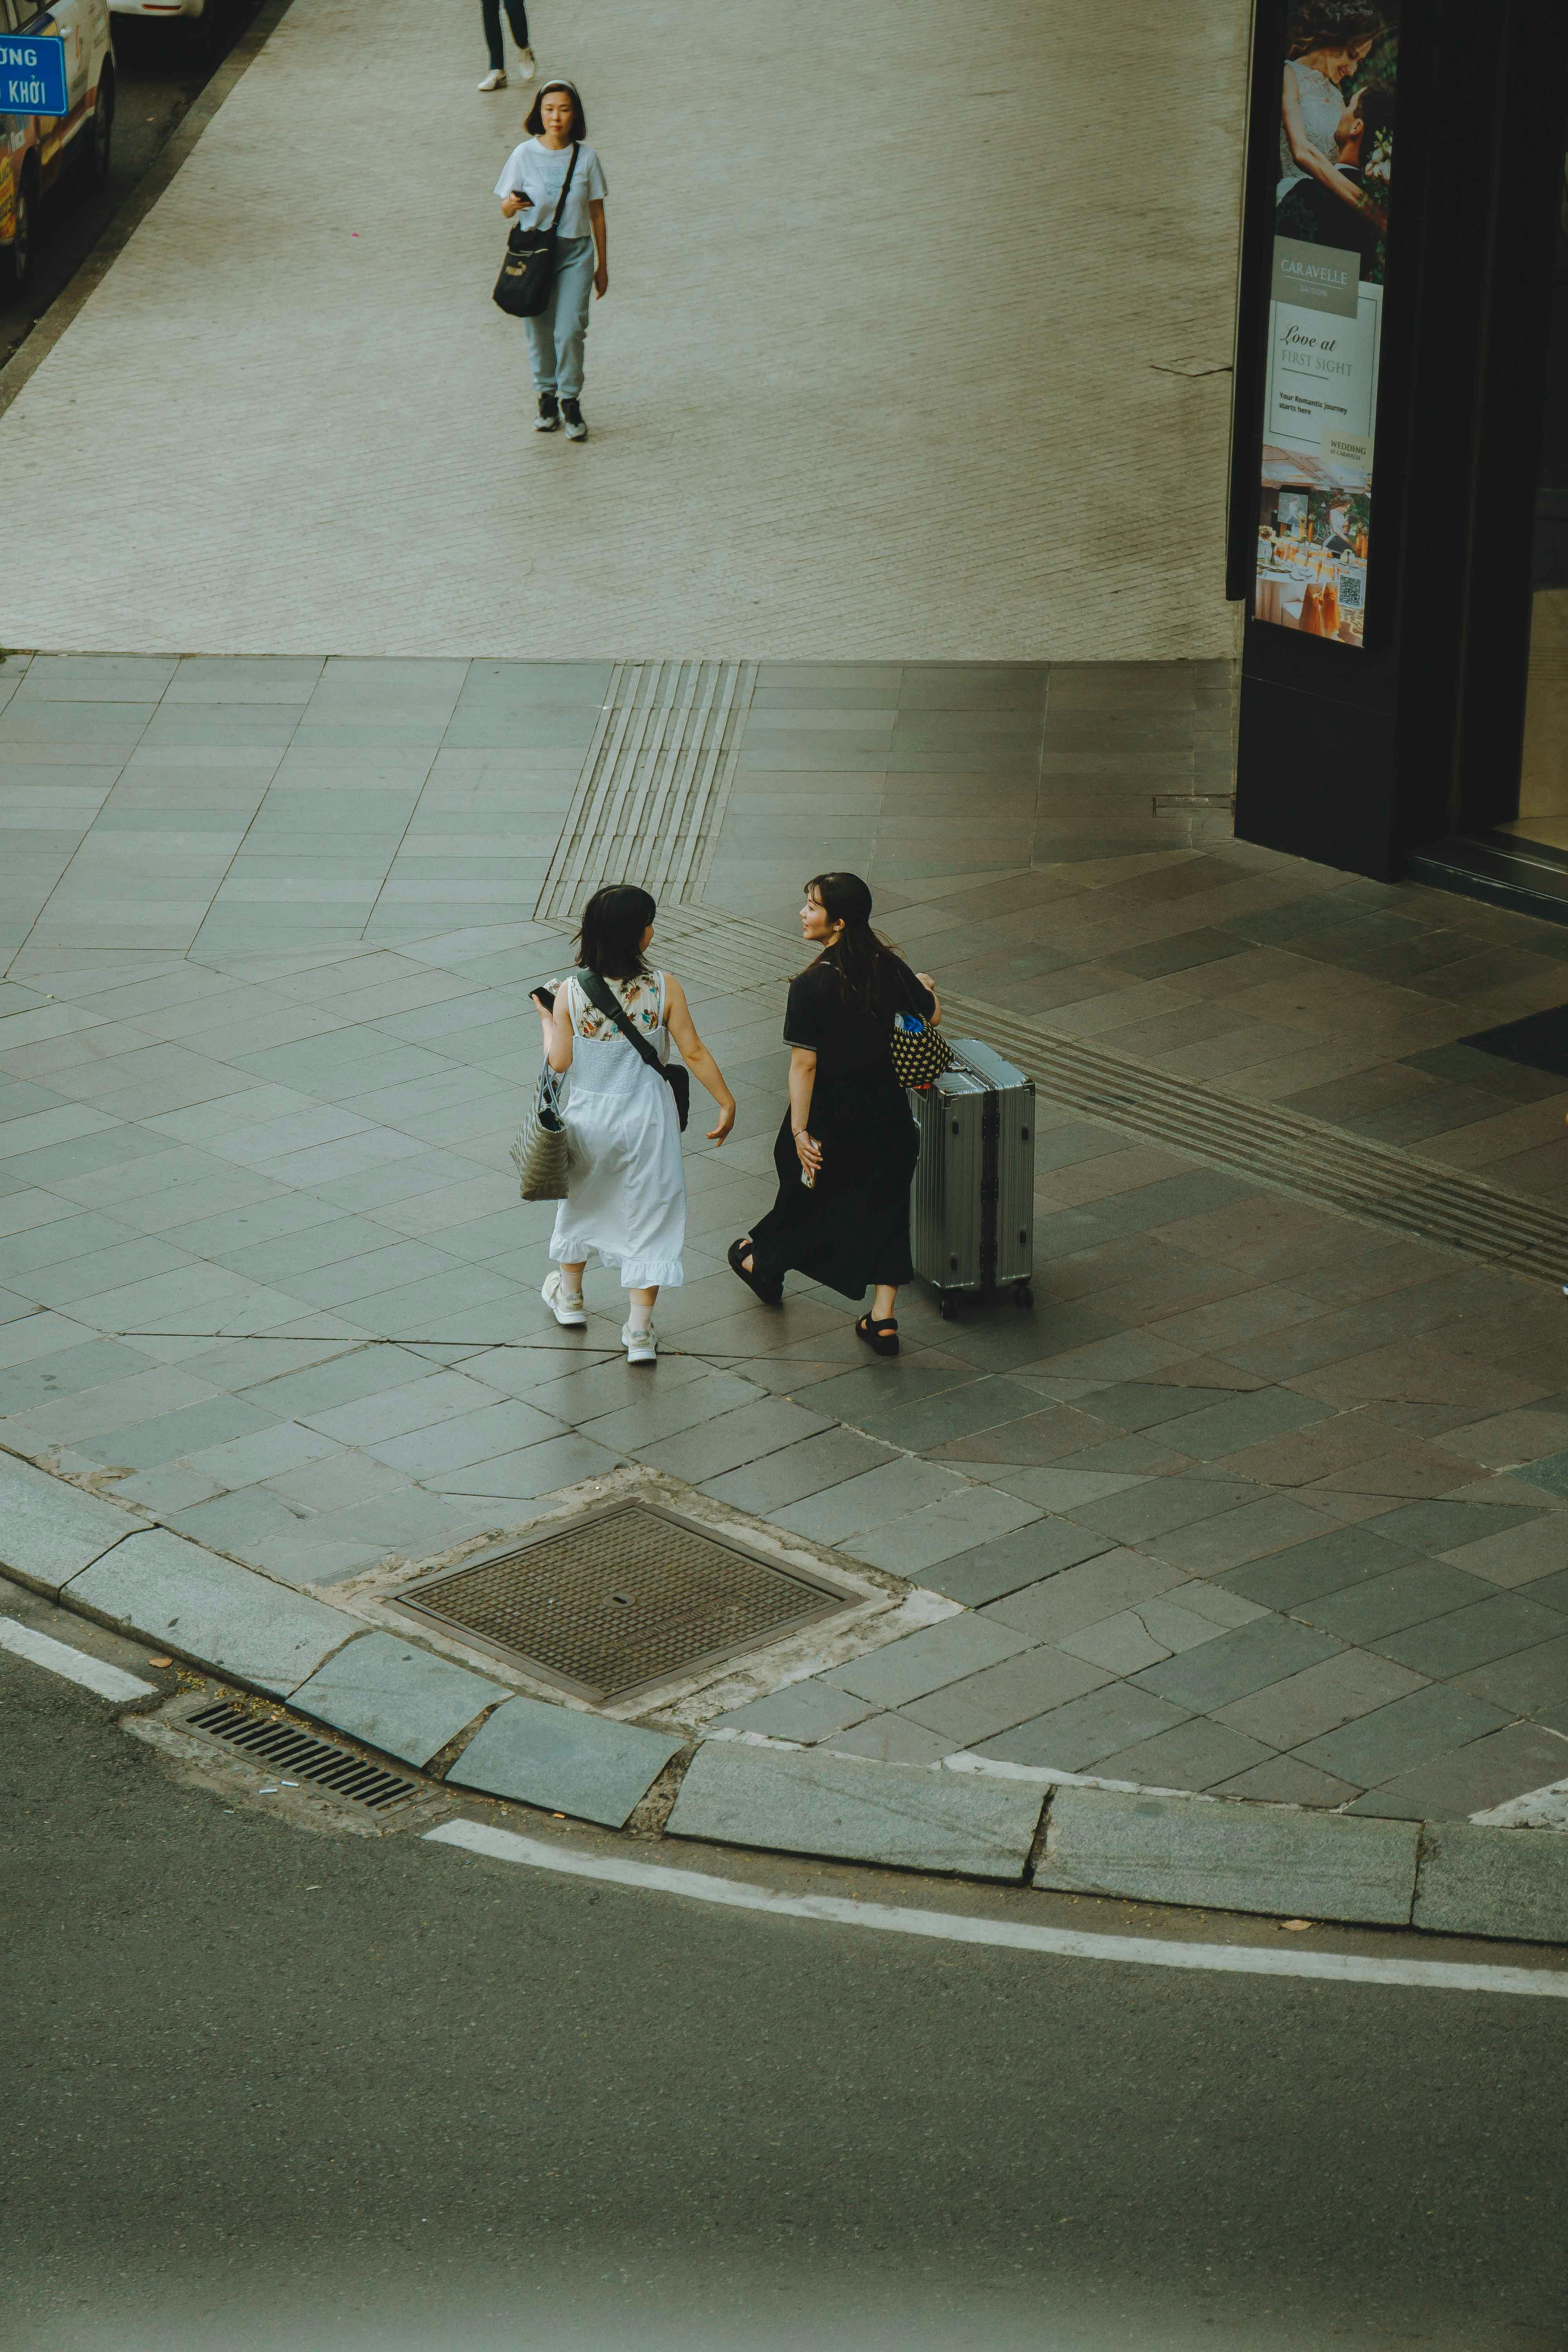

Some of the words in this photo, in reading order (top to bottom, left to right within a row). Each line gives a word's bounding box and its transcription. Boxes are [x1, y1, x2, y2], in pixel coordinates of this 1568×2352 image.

[9, 74, 45, 104] KHỞI
[1281, 260, 1348, 285] CARAVELLE
[1280, 325, 1316, 347] Love
[1321, 340, 1336, 352] at
[1281, 350, 1313, 367] FIRST
[1316, 357, 1353, 376] SIGHT
[1279, 392, 1294, 400] Your
[1295, 396, 1323, 408] Romantic
[1298, 406, 1311, 415] here
[1330, 439, 1367, 455] WEDDING
